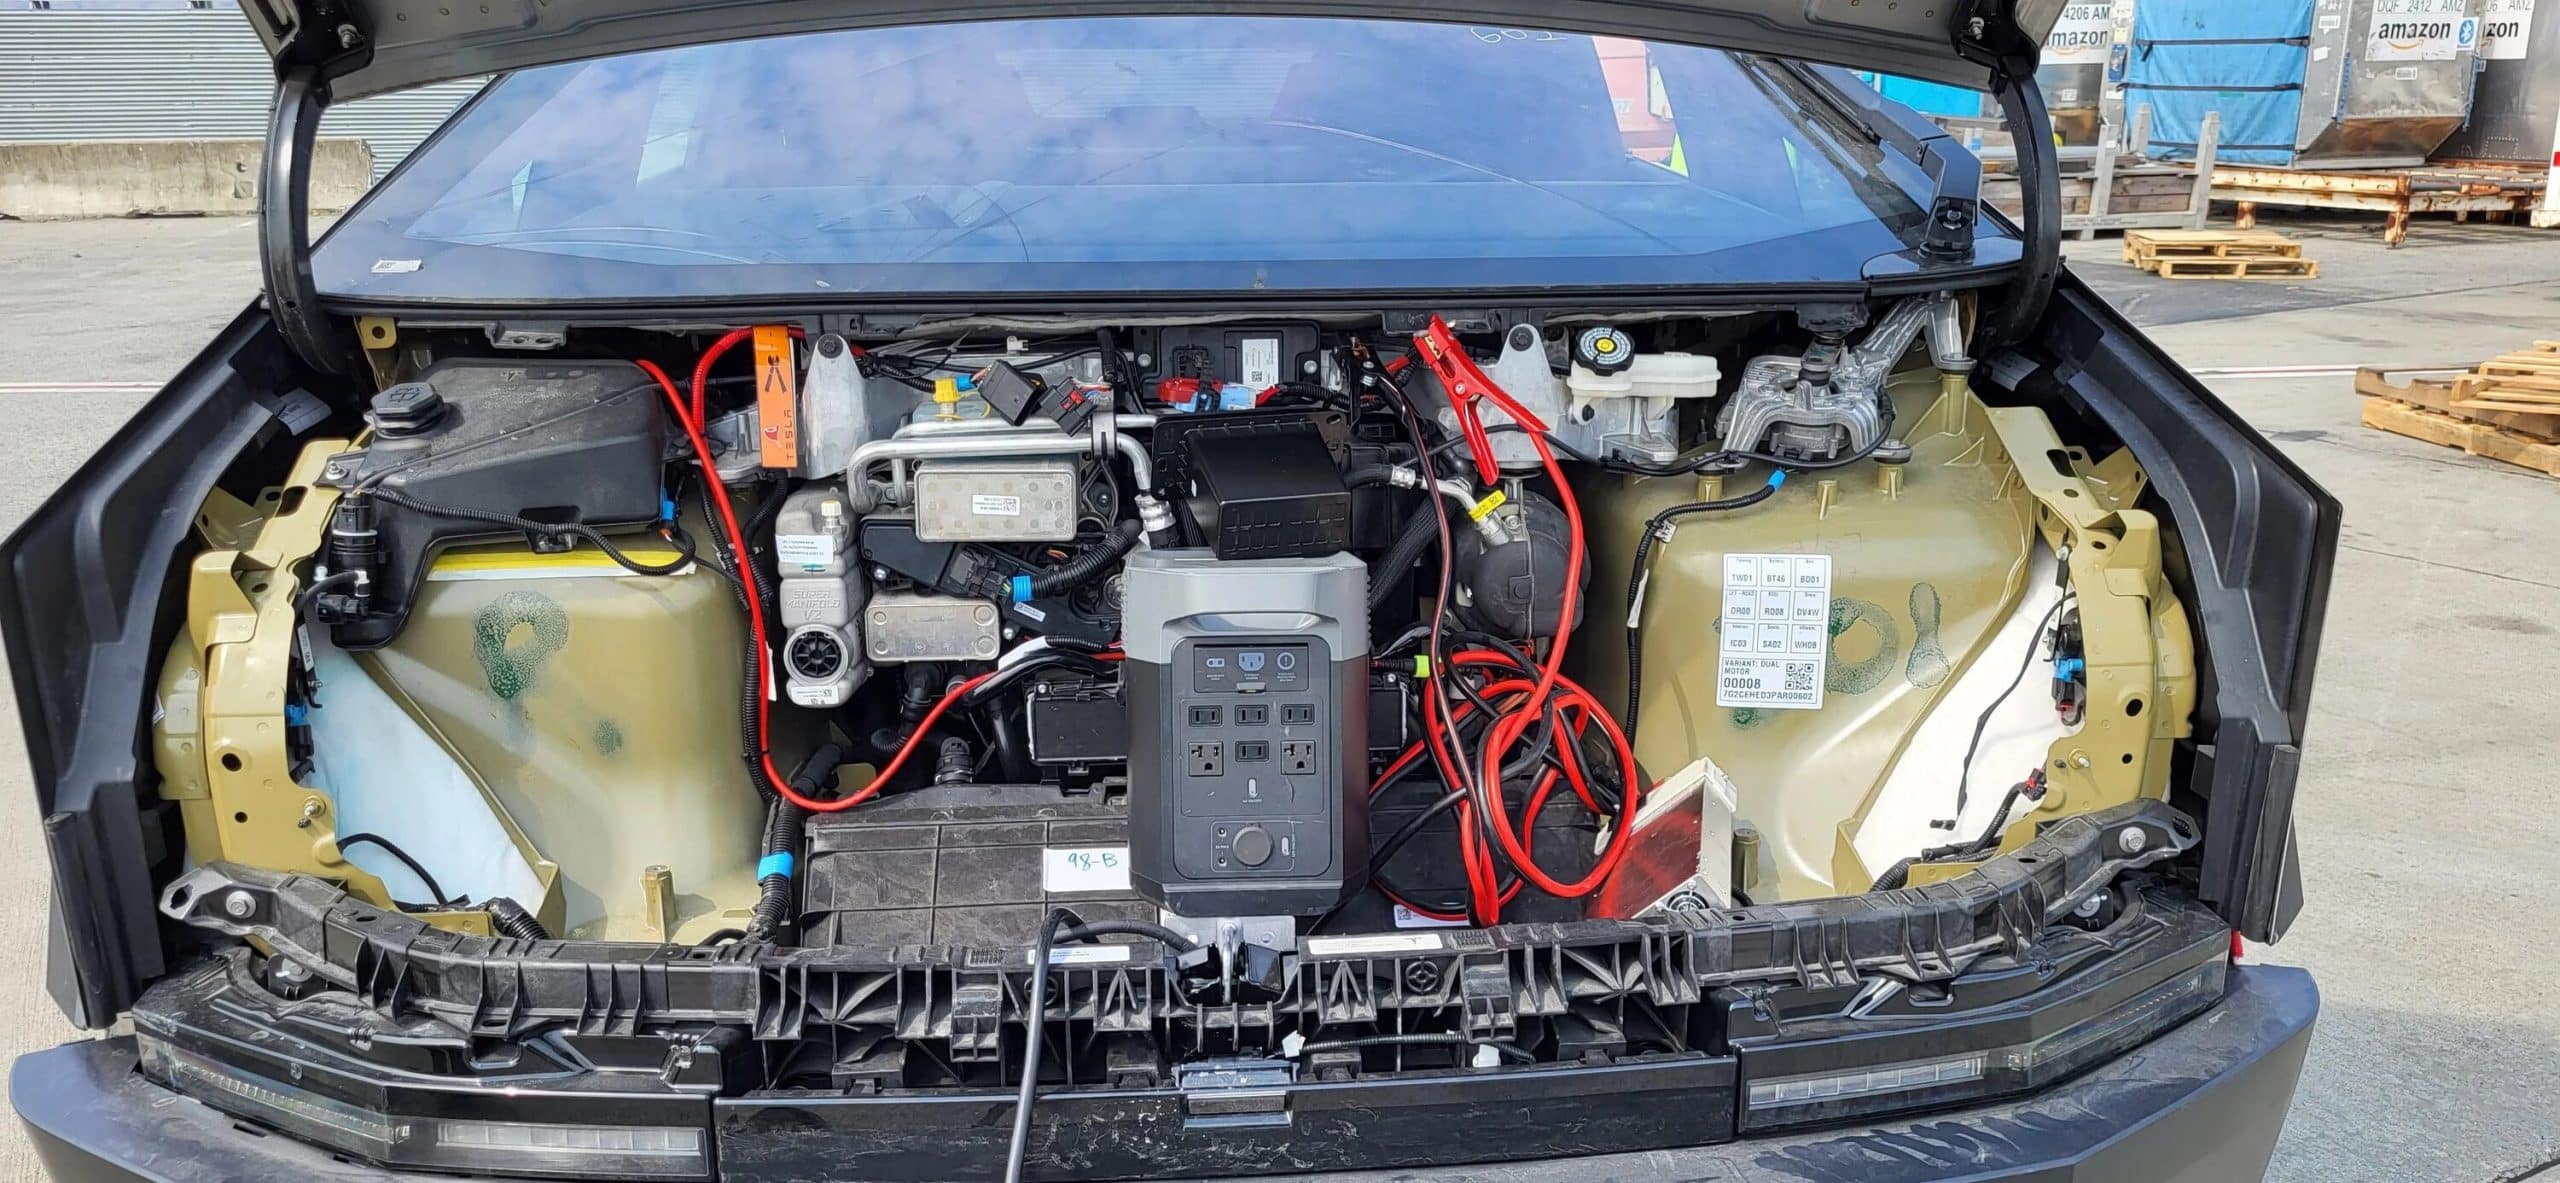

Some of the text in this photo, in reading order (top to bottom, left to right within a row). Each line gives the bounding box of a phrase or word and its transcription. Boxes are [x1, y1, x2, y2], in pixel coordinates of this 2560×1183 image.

[2407, 0, 2432, 12] 2412
[2440, 0, 2463, 12] AMZ
[2063, 7, 2089, 20] 4206
[2378, 22, 2451, 39] amazon
[2482, 22, 2519, 38] zon
[2045, 31, 2108, 46] mazon
[783, 409, 794, 460] TESLA
[793, 591, 830, 599] SUPER
[785, 599, 840, 608] MANIFOLD
[1724, 667, 1750, 675] MOTOR
[1723, 677, 1761, 689] 00008
[1068, 852, 1118, 871] 98-B
